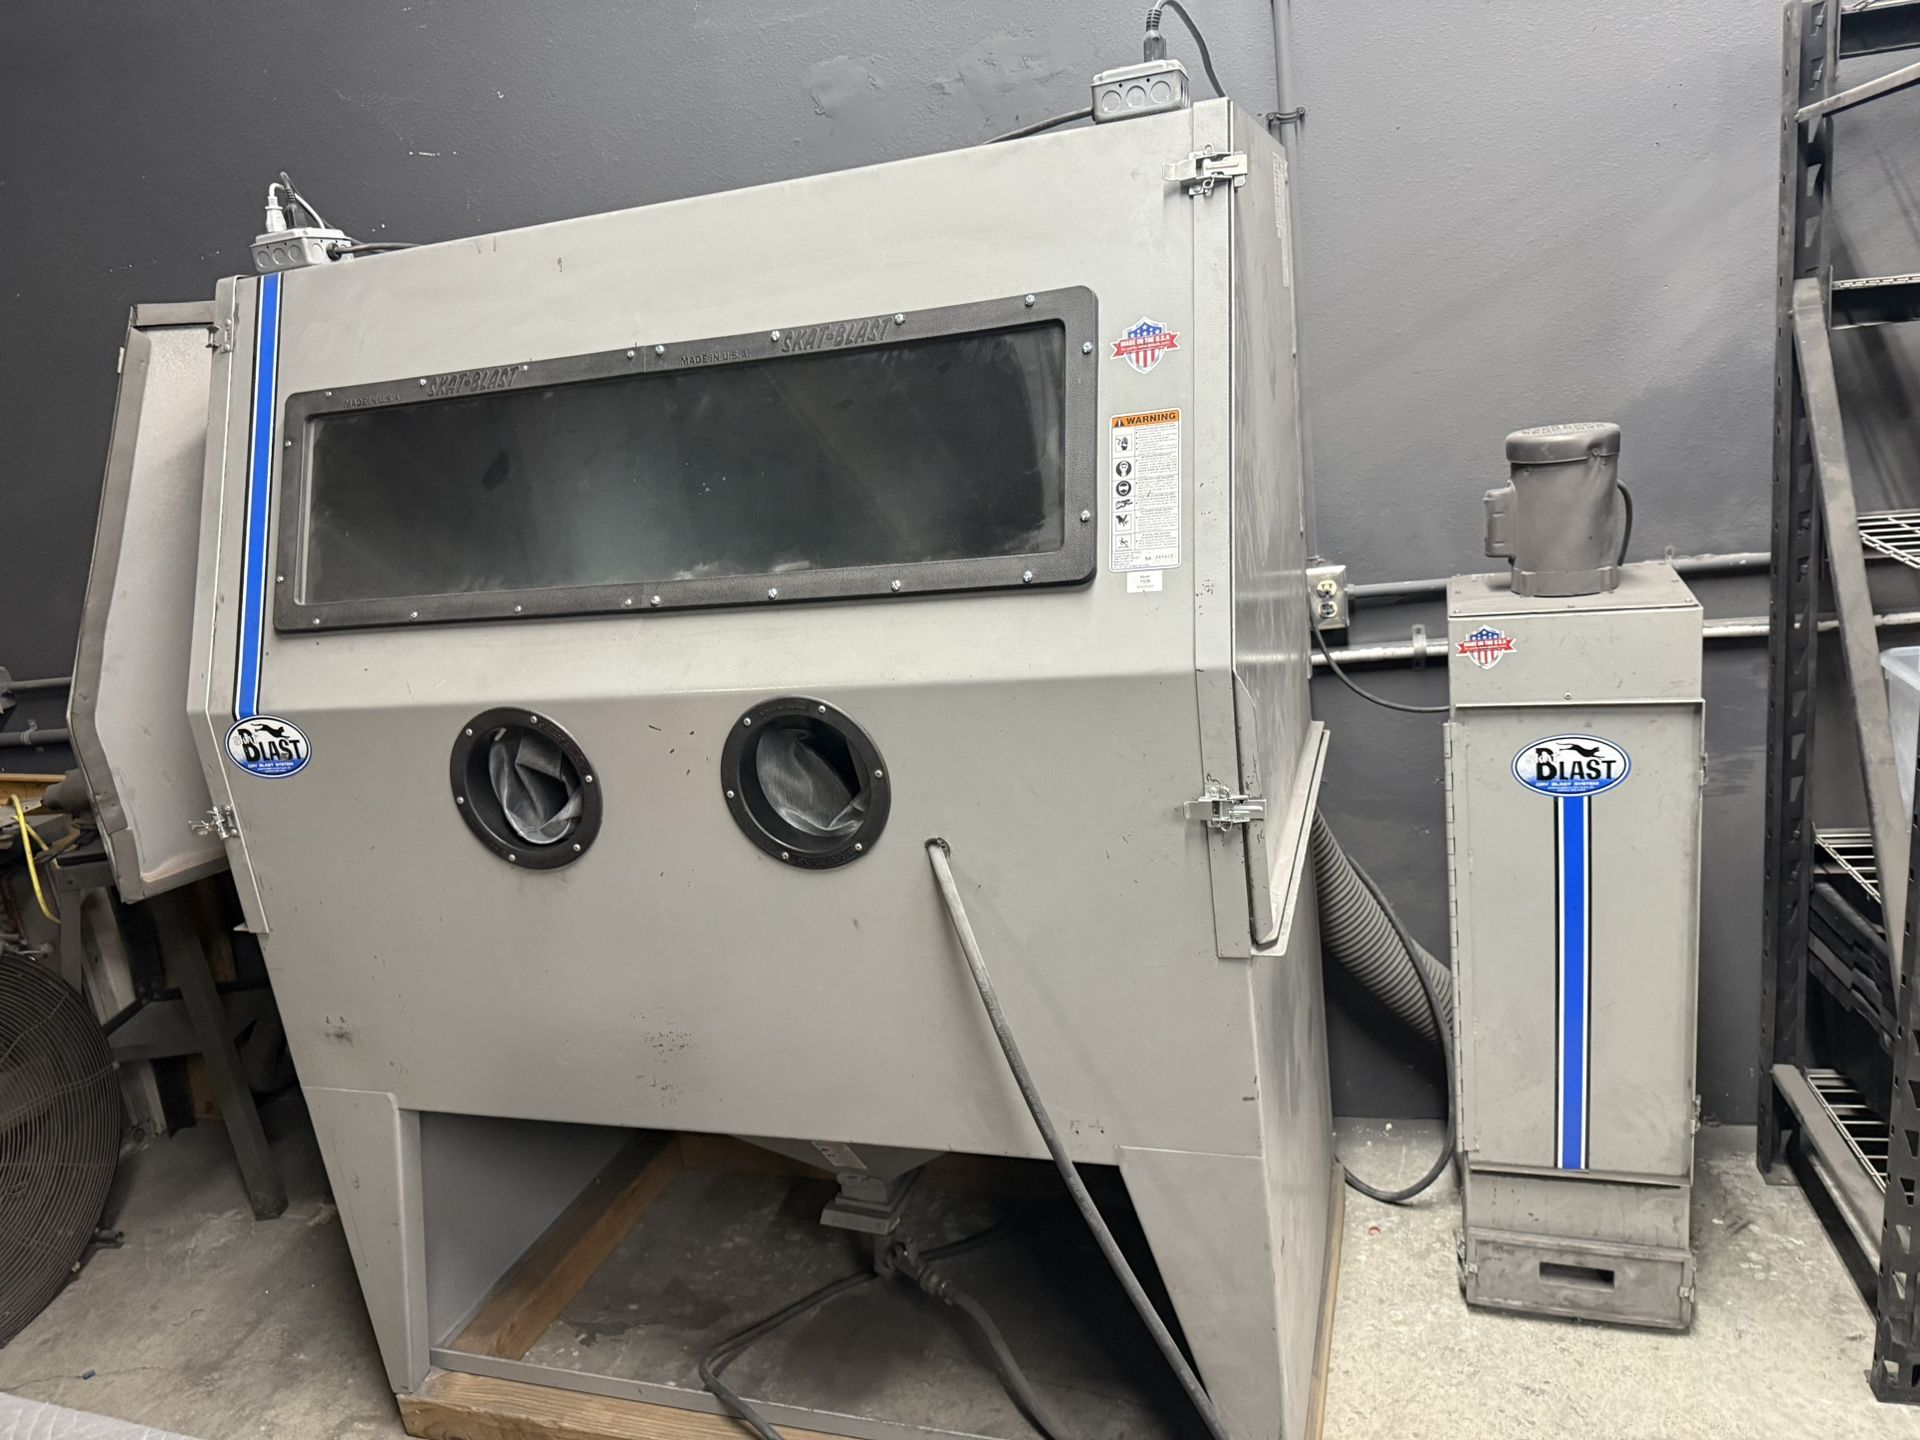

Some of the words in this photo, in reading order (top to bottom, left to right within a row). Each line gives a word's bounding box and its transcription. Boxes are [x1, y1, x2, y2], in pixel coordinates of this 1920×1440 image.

[782, 318, 892, 352] SKAT-BLAST
[680, 353, 708, 366] MADE
[710, 352, 720, 363] IN
[428, 365, 520, 398] SKAT-BLAST
[1126, 412, 1176, 425] WARNING
[237, 728, 301, 762] BLAST
[1535, 748, 1617, 781] BLAST
